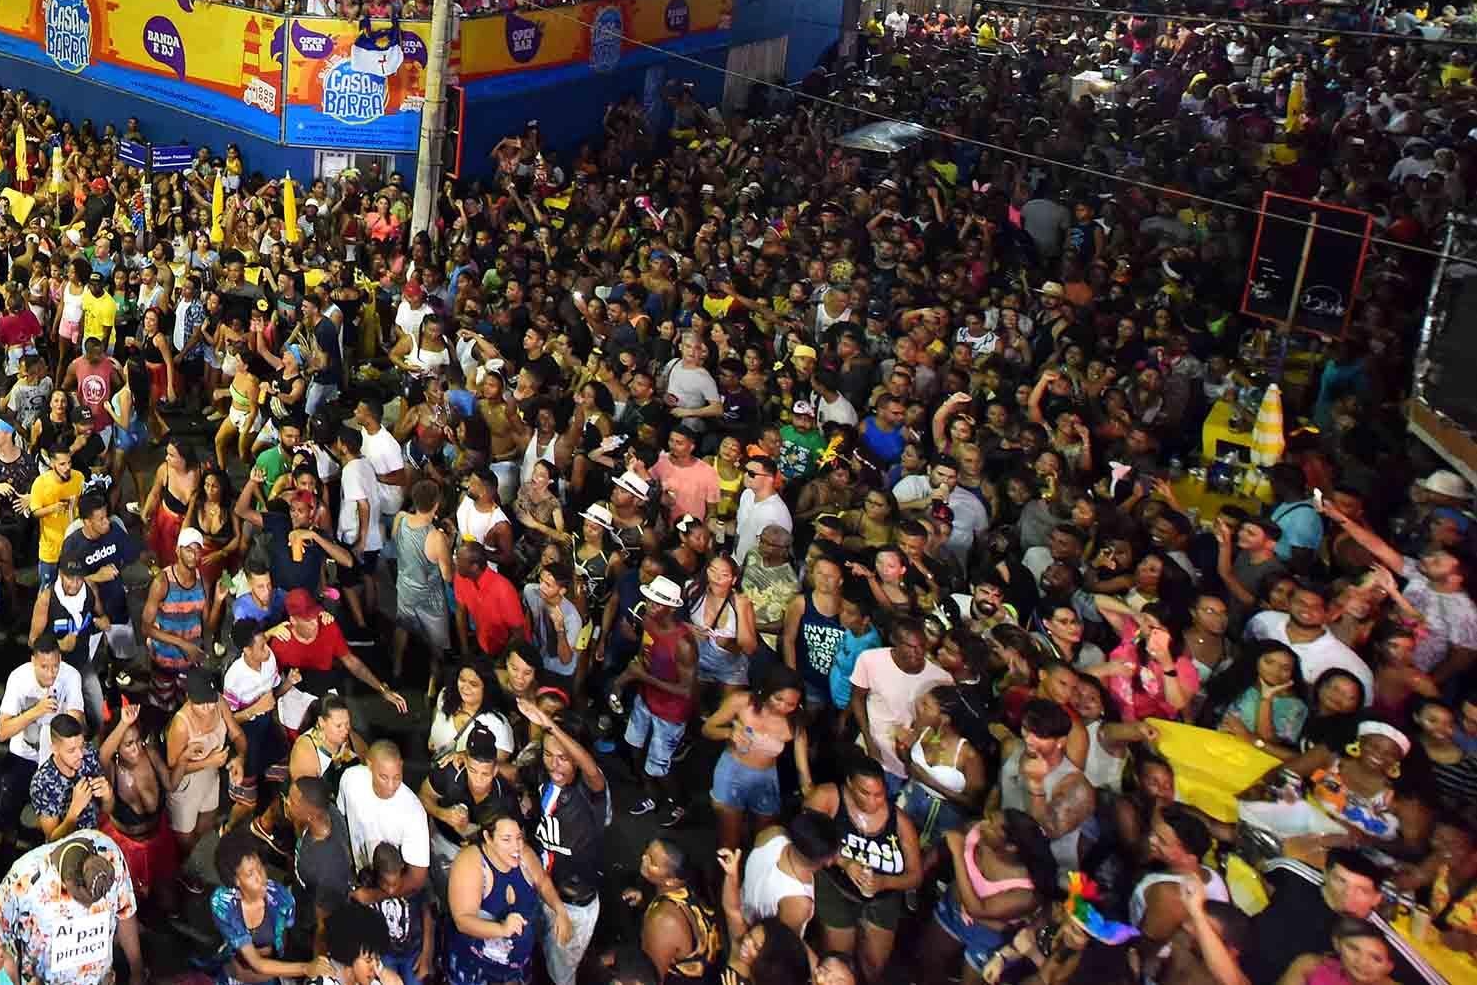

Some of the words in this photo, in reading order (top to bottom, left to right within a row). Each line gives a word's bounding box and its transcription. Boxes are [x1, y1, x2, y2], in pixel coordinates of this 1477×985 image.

[45, 22, 91, 66] BARRA
[147, 29, 181, 49] BANDA
[299, 36, 326, 46] OPEN
[511, 26, 535, 42] OPEN
[153, 43, 160, 54] E
[161, 44, 175, 57] DJ
[301, 43, 324, 52] BAR
[513, 37, 533, 52] BAR
[331, 70, 372, 94] CASA
[323, 89, 385, 119] BARRA
[85, 543, 117, 566] adidas
[56, 923, 74, 938] Ai
[77, 922, 105, 943] pai
[56, 940, 105, 964] pirraça
